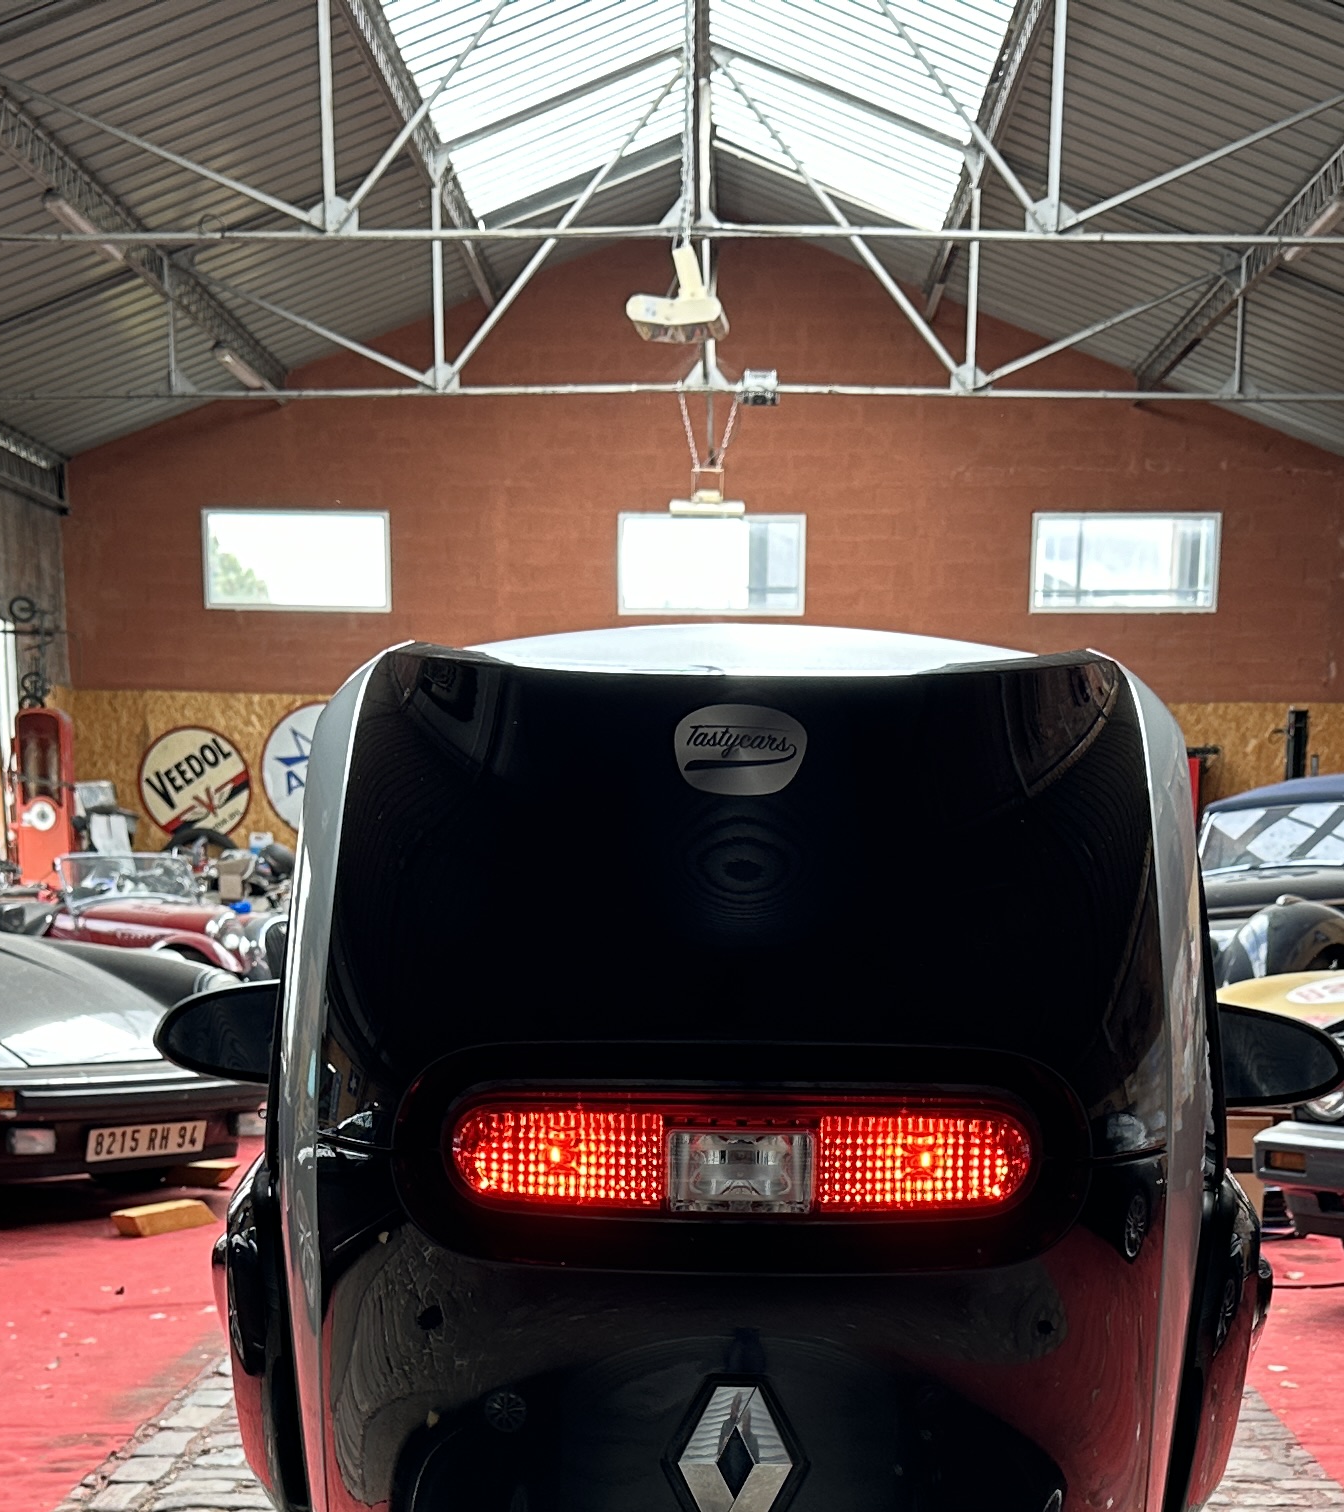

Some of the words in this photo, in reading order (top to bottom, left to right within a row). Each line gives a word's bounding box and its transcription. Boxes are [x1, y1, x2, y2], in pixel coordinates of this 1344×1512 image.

[686, 725, 794, 759] Tastycars
[144, 736, 234, 811] VEEDOL
[94, 1128, 140, 1156] 8215
[146, 1126, 170, 1151] RH
[176, 1124, 198, 1149] 94
